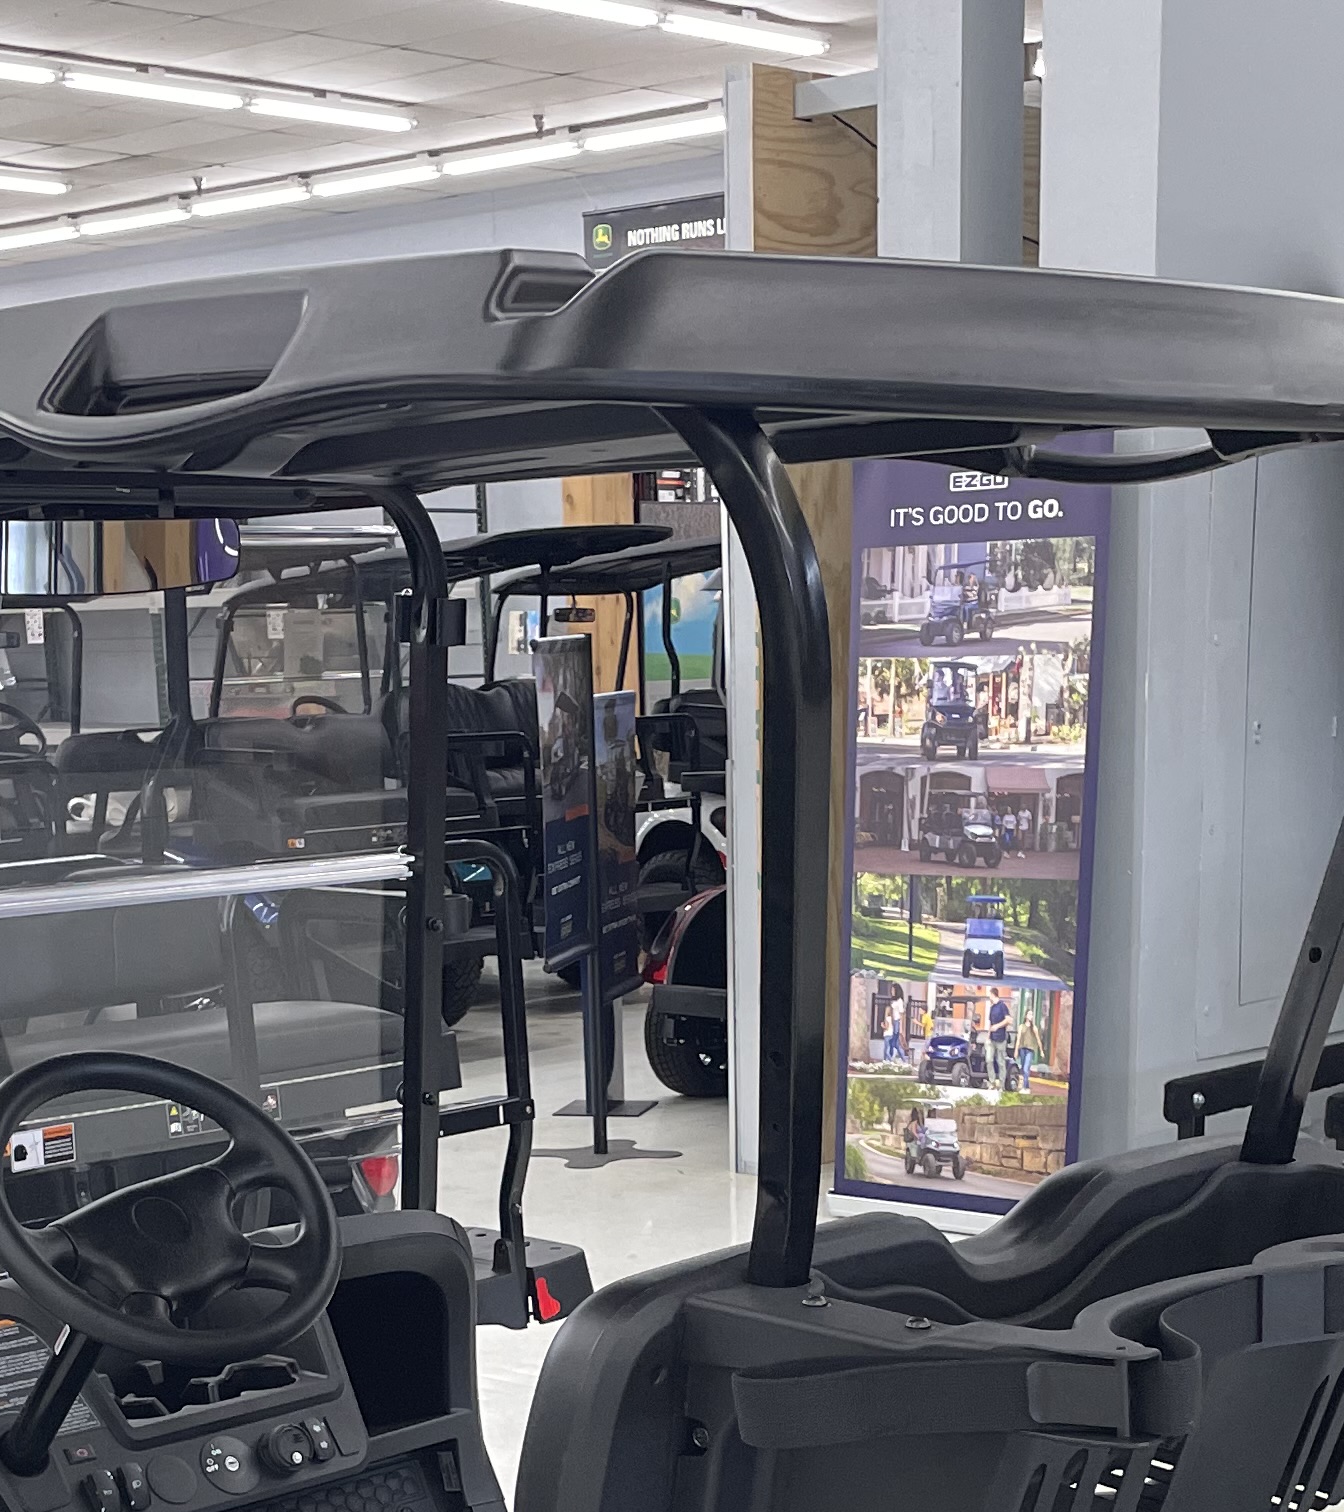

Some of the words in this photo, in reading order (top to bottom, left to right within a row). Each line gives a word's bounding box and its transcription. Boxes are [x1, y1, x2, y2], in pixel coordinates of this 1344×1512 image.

[627, 223, 680, 247] NOTHING
[681, 218, 715, 240] RUNS
[890, 507, 924, 527] IT'S
[929, 503, 989, 525] GOOD
[994, 501, 1022, 520] TO
[1028, 499, 1064, 519] GO.
